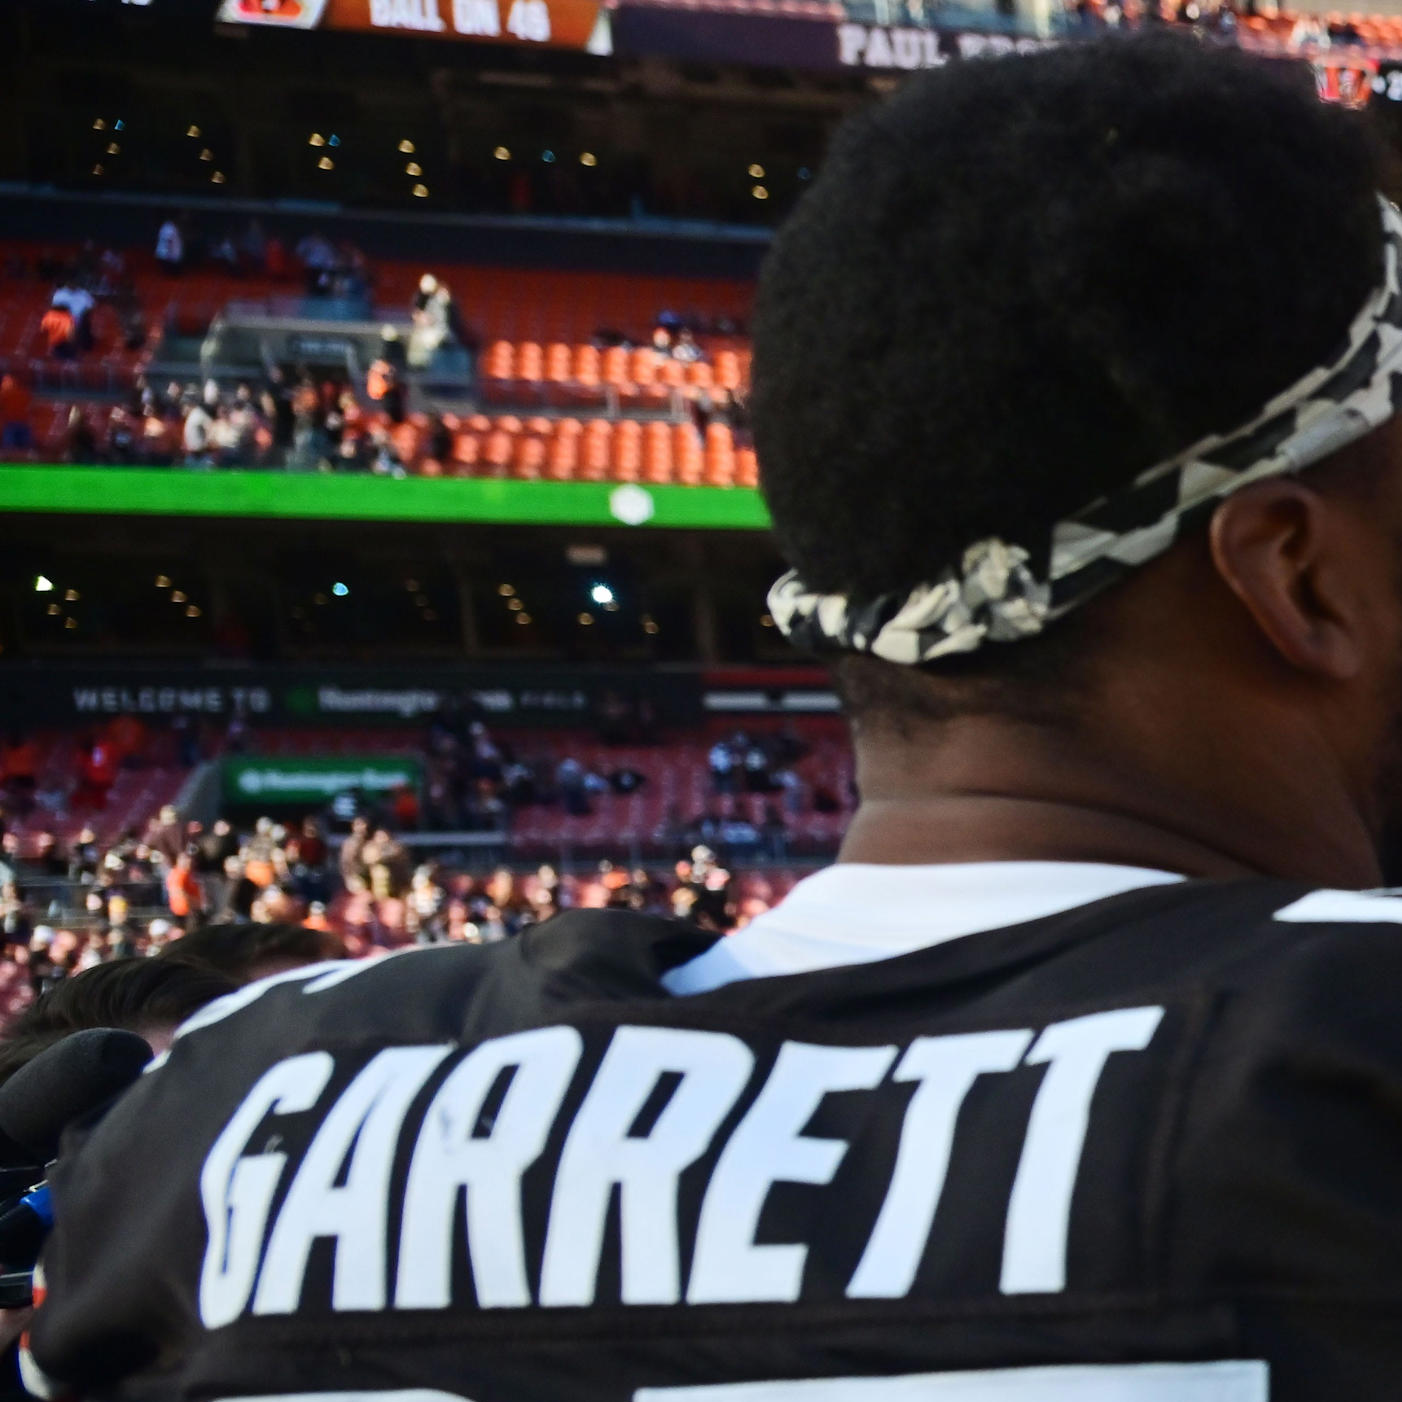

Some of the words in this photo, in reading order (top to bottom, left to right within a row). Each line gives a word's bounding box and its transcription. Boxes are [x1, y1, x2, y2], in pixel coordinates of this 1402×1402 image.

[838, 23, 948, 70] PAUL
[73, 686, 223, 714] WELCOME
[199, 1005, 1166, 1330] GARRETT
